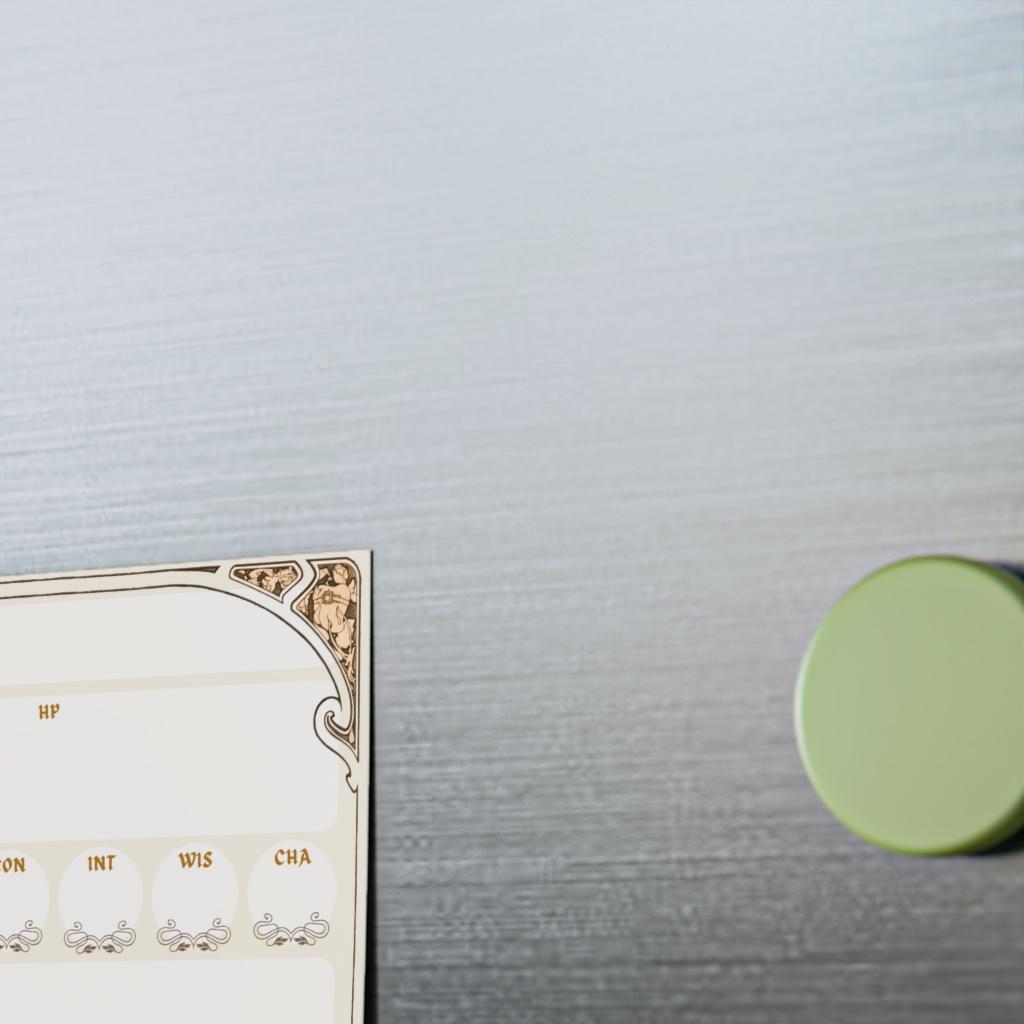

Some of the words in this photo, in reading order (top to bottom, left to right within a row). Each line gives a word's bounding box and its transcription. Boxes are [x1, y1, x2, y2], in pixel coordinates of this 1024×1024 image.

[37, 703, 61, 721] HP
[87, 853, 116, 872] INT
[178, 850, 213, 870] WIS
[273, 847, 312, 867] CHA
